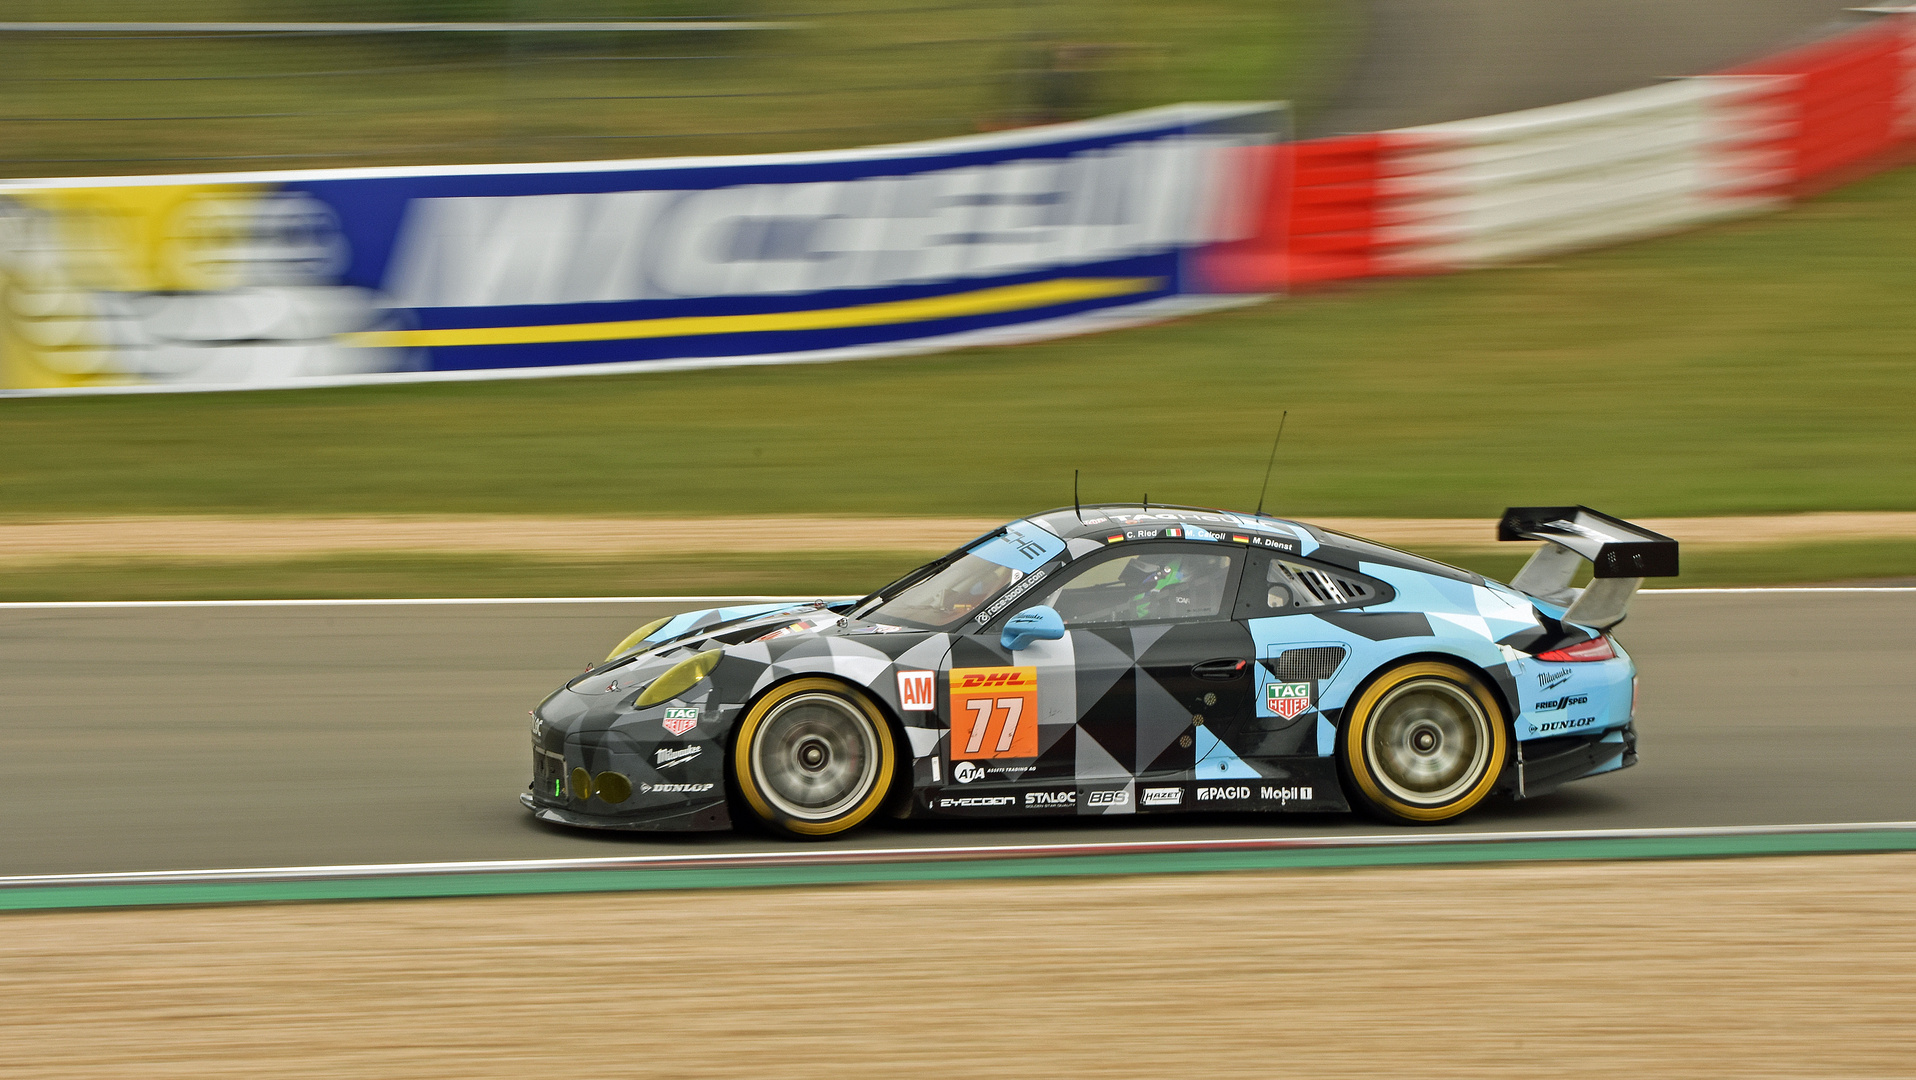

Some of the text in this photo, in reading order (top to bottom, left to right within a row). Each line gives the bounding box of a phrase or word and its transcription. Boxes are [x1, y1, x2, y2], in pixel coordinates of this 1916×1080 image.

[1126, 529, 1158, 539] C. Ried
[1252, 536, 1293, 551] M. Dienst
[962, 672, 1026, 688] DHL
[904, 677, 932, 705] AM
[1270, 685, 1306, 697] TAG
[1270, 698, 1308, 717] HEUER
[1535, 696, 1588, 710] FRIED SPED
[668, 709, 696, 718] TAG
[964, 697, 1025, 754] 77
[1539, 716, 1596, 732] DUNLOP
[957, 766, 986, 780] ATA
[652, 783, 714, 792] DUNLOP
[1209, 786, 1251, 800] PAGID
[1260, 786, 1298, 803] Mobil
[1025, 791, 1076, 804] STALOC
[1089, 791, 1128, 806] BBS
[1145, 792, 1180, 801] HAZET
